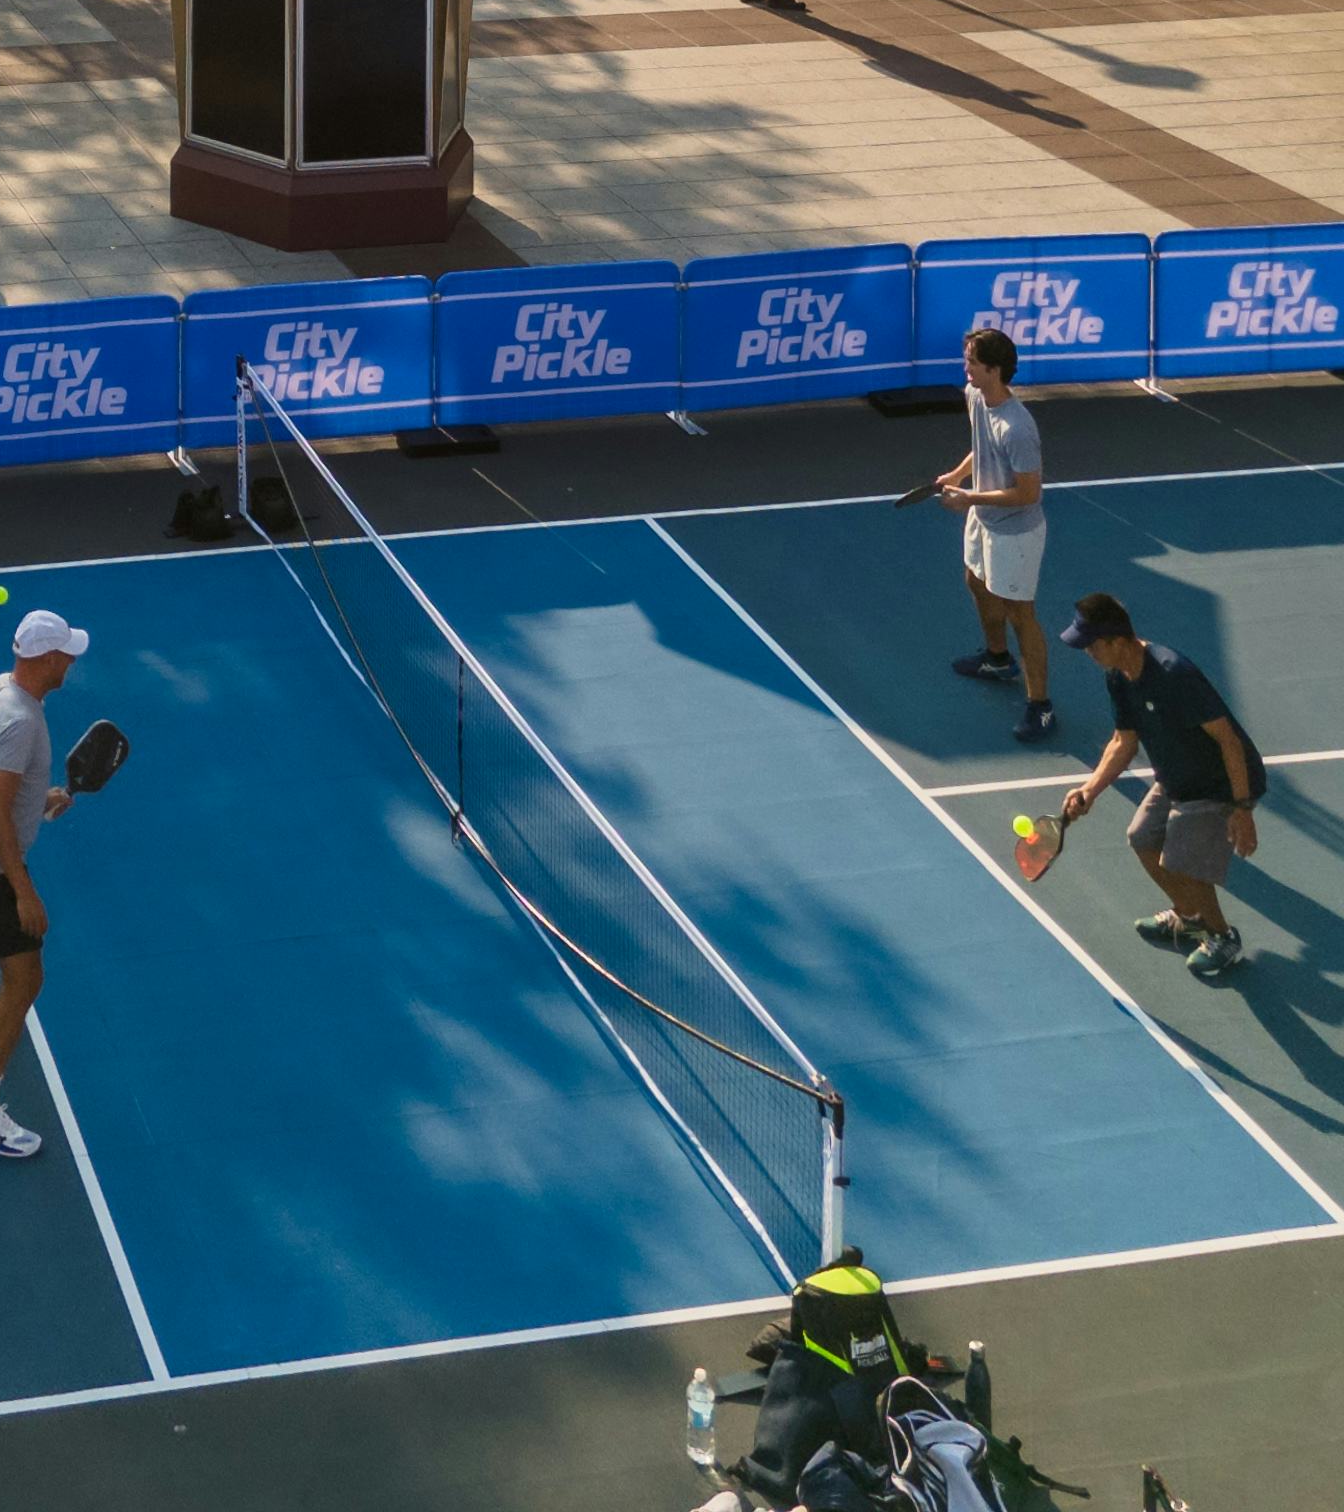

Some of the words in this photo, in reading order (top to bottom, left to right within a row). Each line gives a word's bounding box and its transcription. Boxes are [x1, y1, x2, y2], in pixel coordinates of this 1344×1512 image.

[991, 271, 1080, 314] City
[1228, 261, 1316, 305] City
[513, 303, 606, 347] City
[756, 287, 844, 333] City
[1206, 293, 1340, 338] Pickle
[1, 342, 101, 388] City
[264, 321, 358, 366] City
[491, 338, 631, 383] Pickle
[736, 321, 867, 367] Pickle
